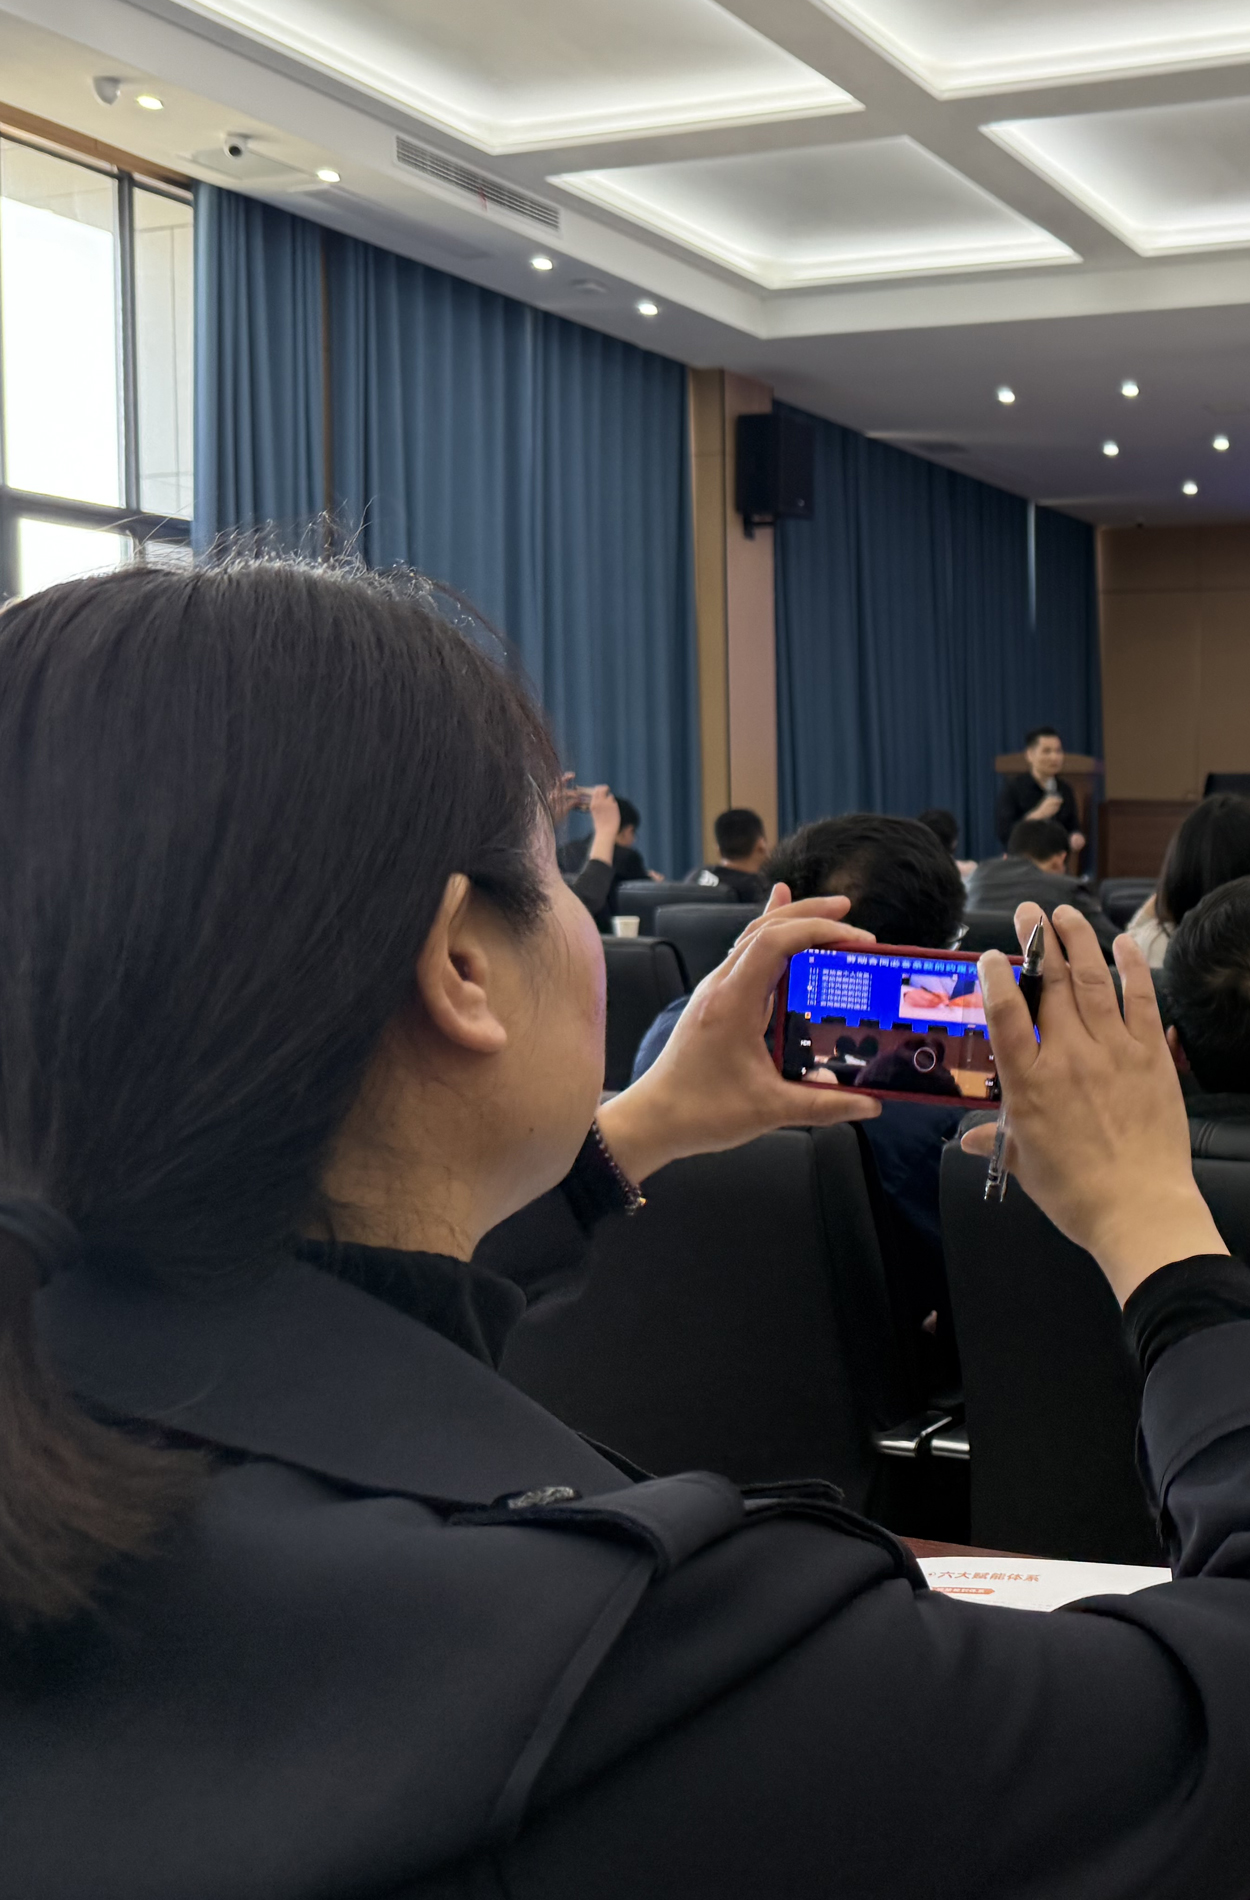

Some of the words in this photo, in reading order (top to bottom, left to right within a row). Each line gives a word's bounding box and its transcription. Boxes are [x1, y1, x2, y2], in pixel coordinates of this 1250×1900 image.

[937, 1570, 1041, 1583] 六大赋能体系
